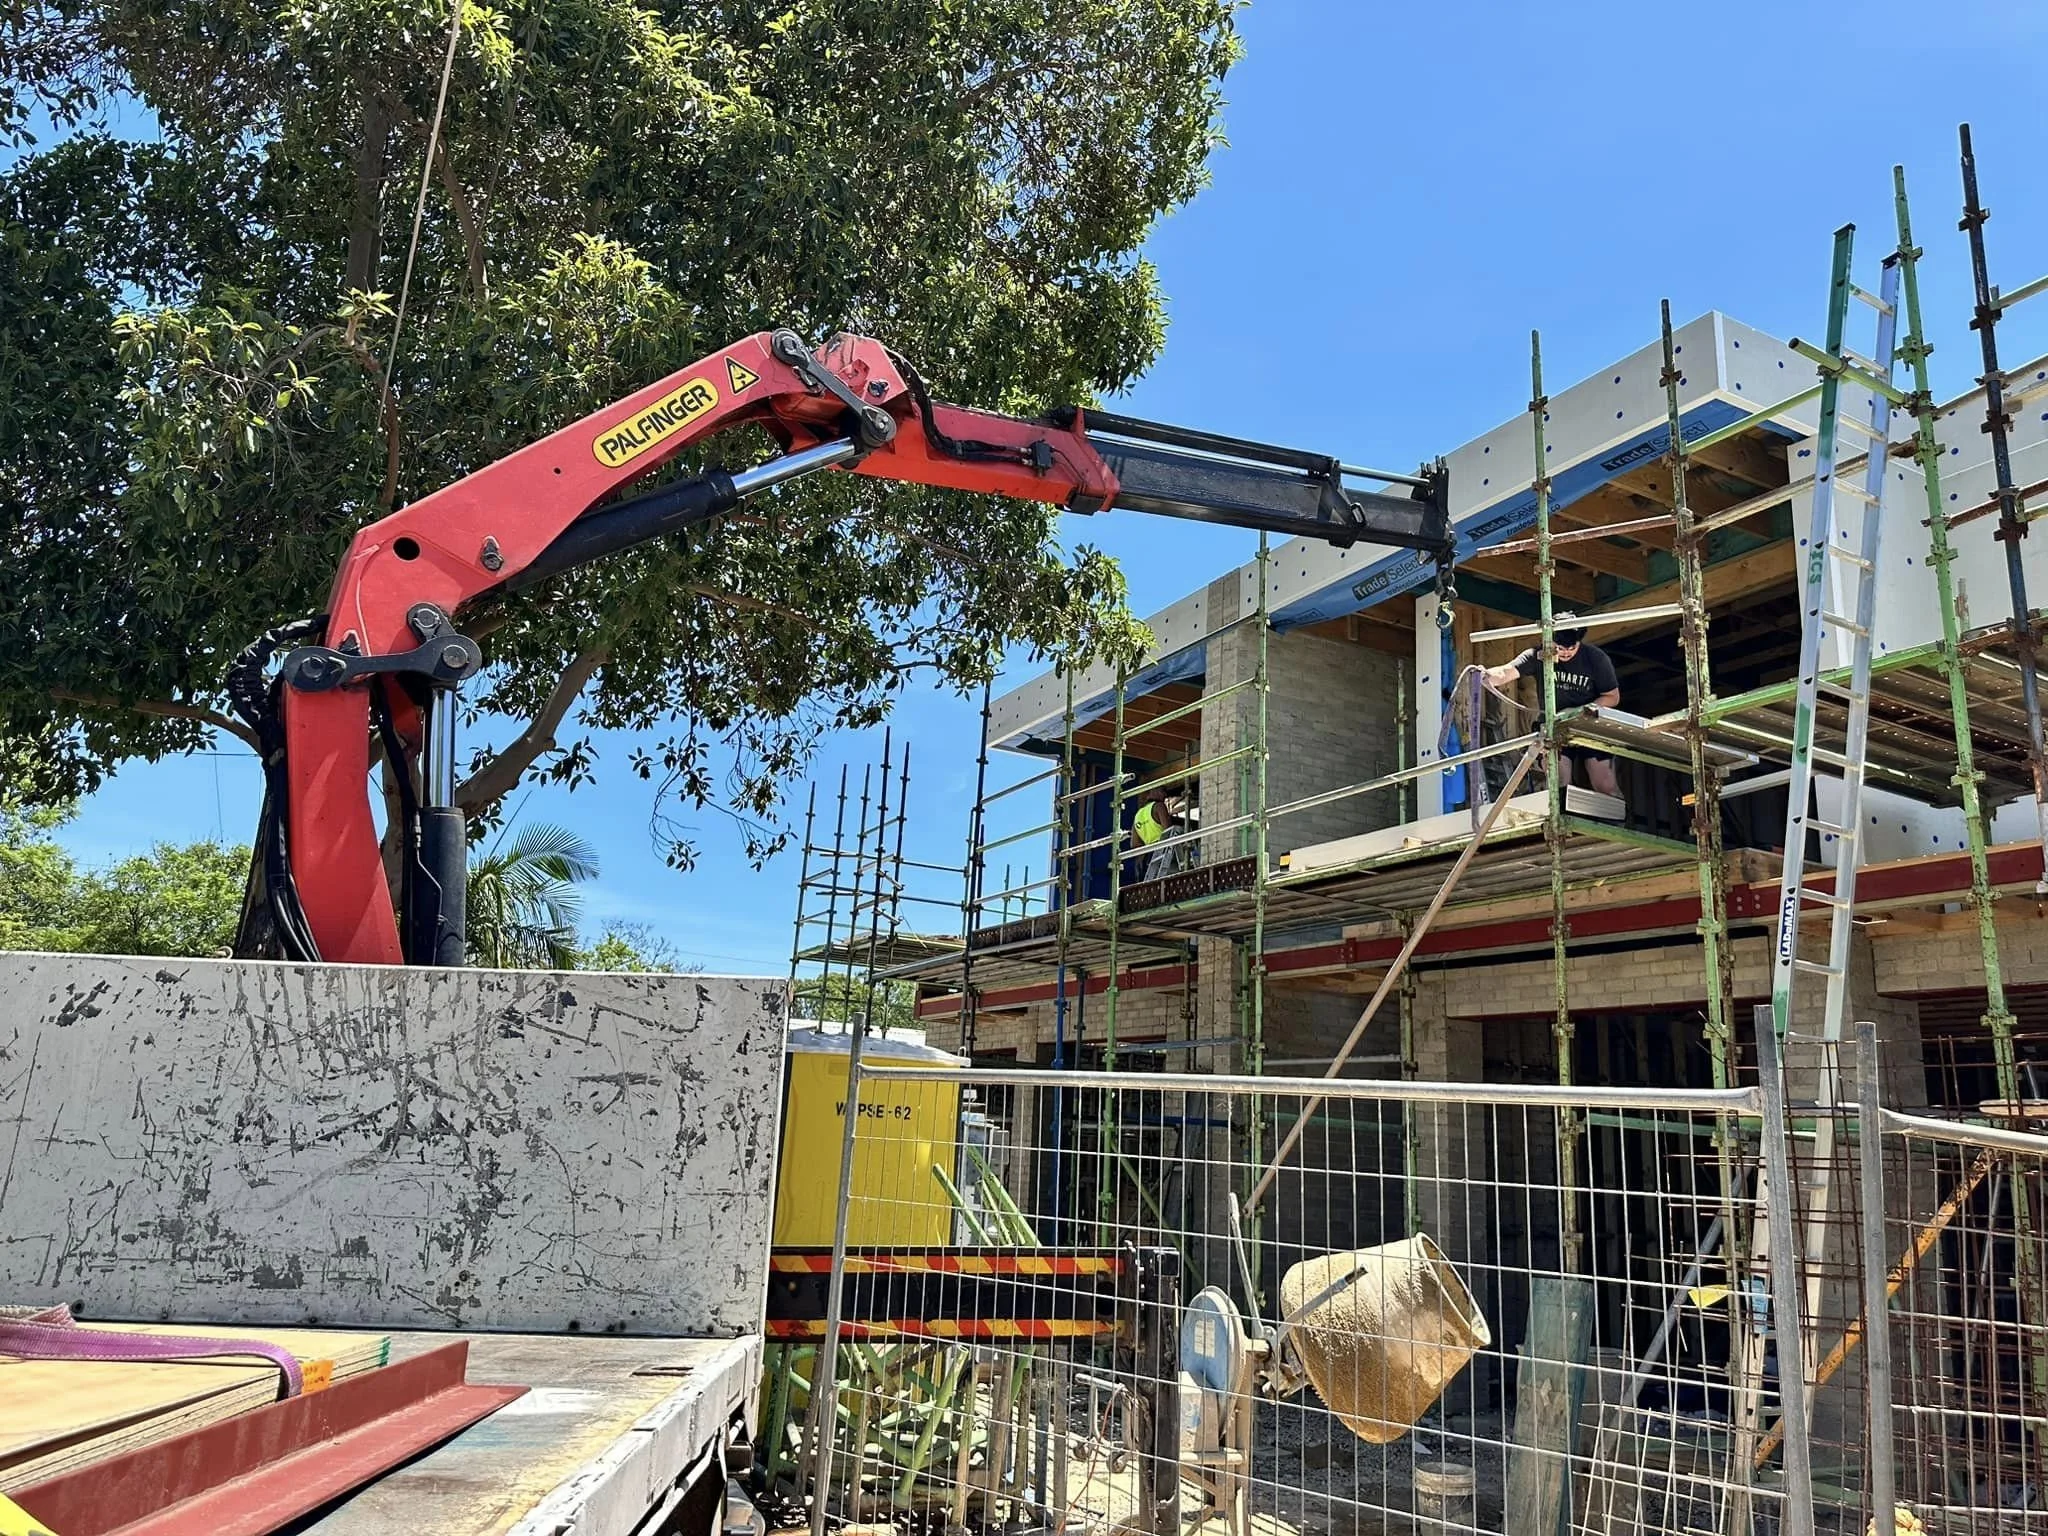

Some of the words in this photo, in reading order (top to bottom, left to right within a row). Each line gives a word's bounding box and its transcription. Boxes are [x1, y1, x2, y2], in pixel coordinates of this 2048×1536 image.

[600, 384, 713, 462] PALFINGER
[1604, 447, 1651, 469] Trade
[1355, 576, 1387, 597] Trade
